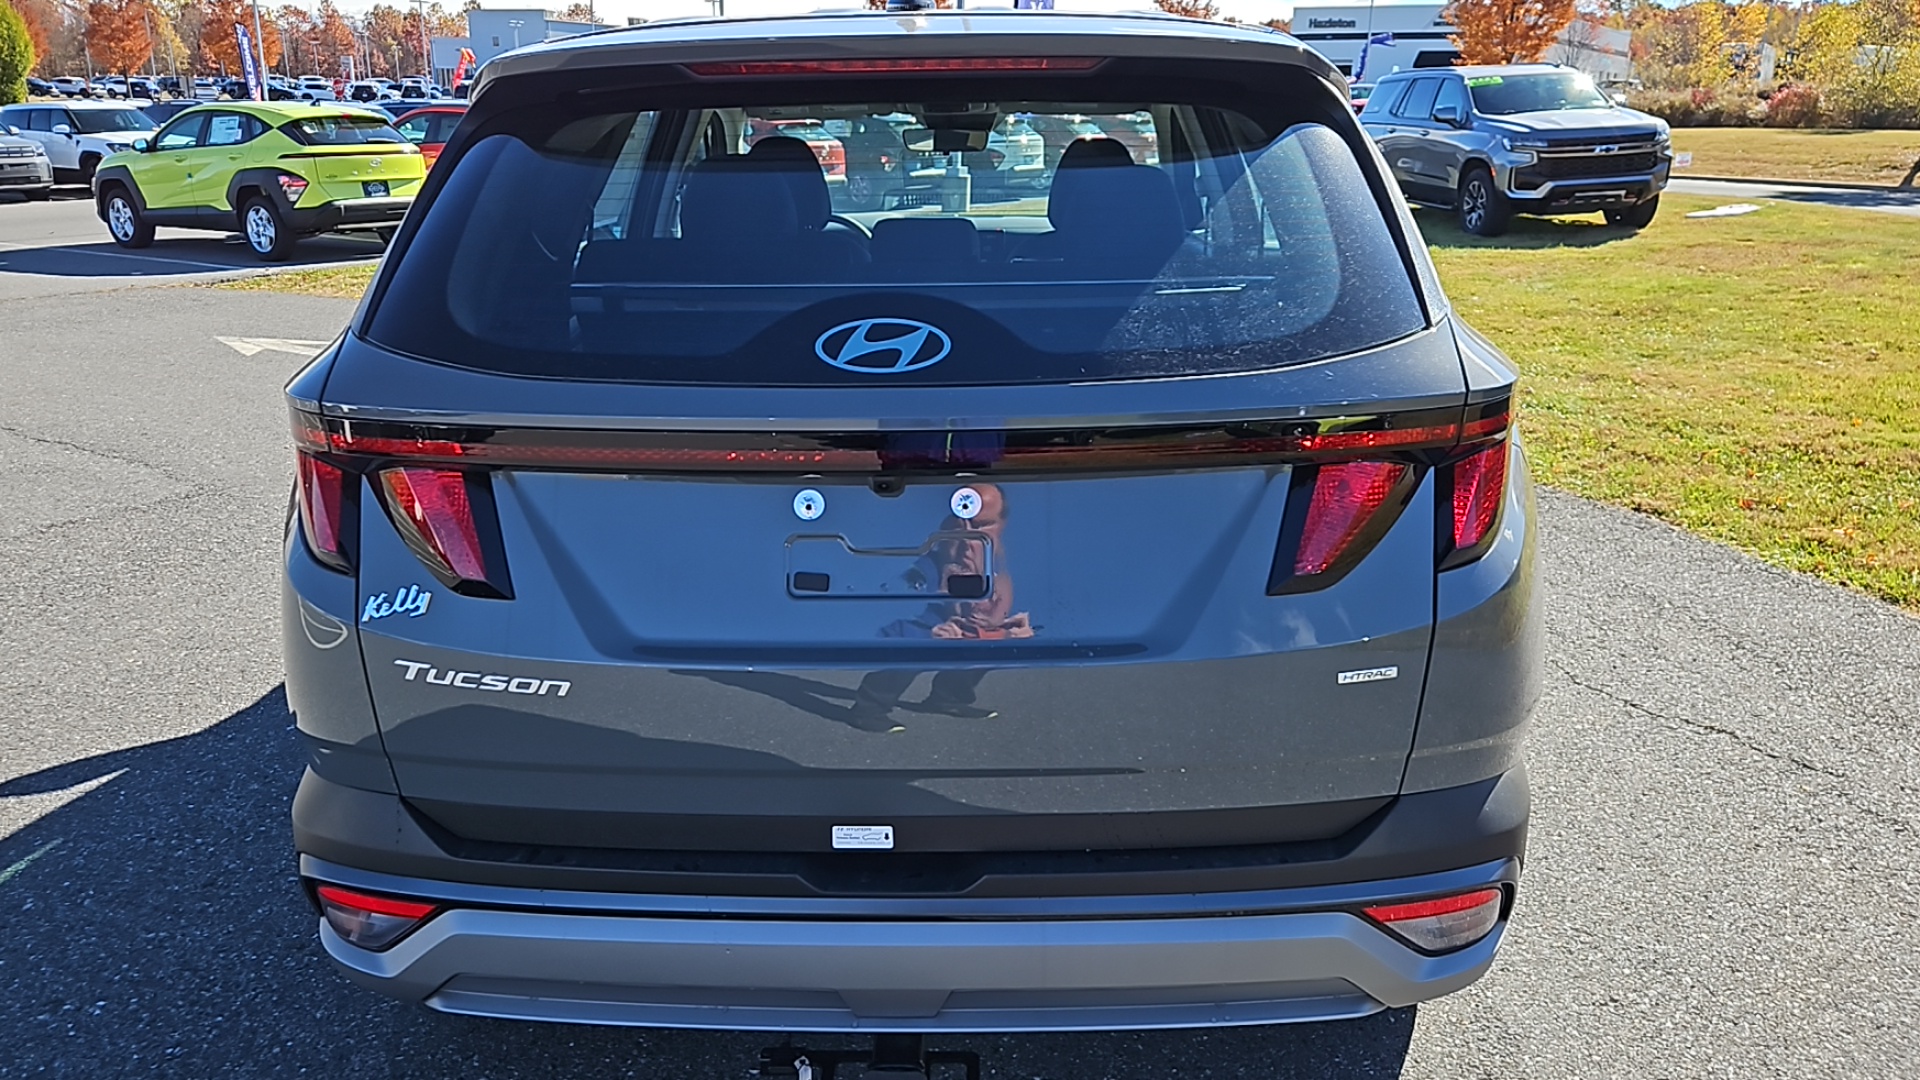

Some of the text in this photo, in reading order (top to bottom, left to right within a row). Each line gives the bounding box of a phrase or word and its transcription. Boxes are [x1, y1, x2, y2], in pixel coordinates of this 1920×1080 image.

[1309, 18, 1356, 28] Hazleton
[361, 584, 431, 622] Kelly
[1343, 669, 1394, 682] HTRAC
